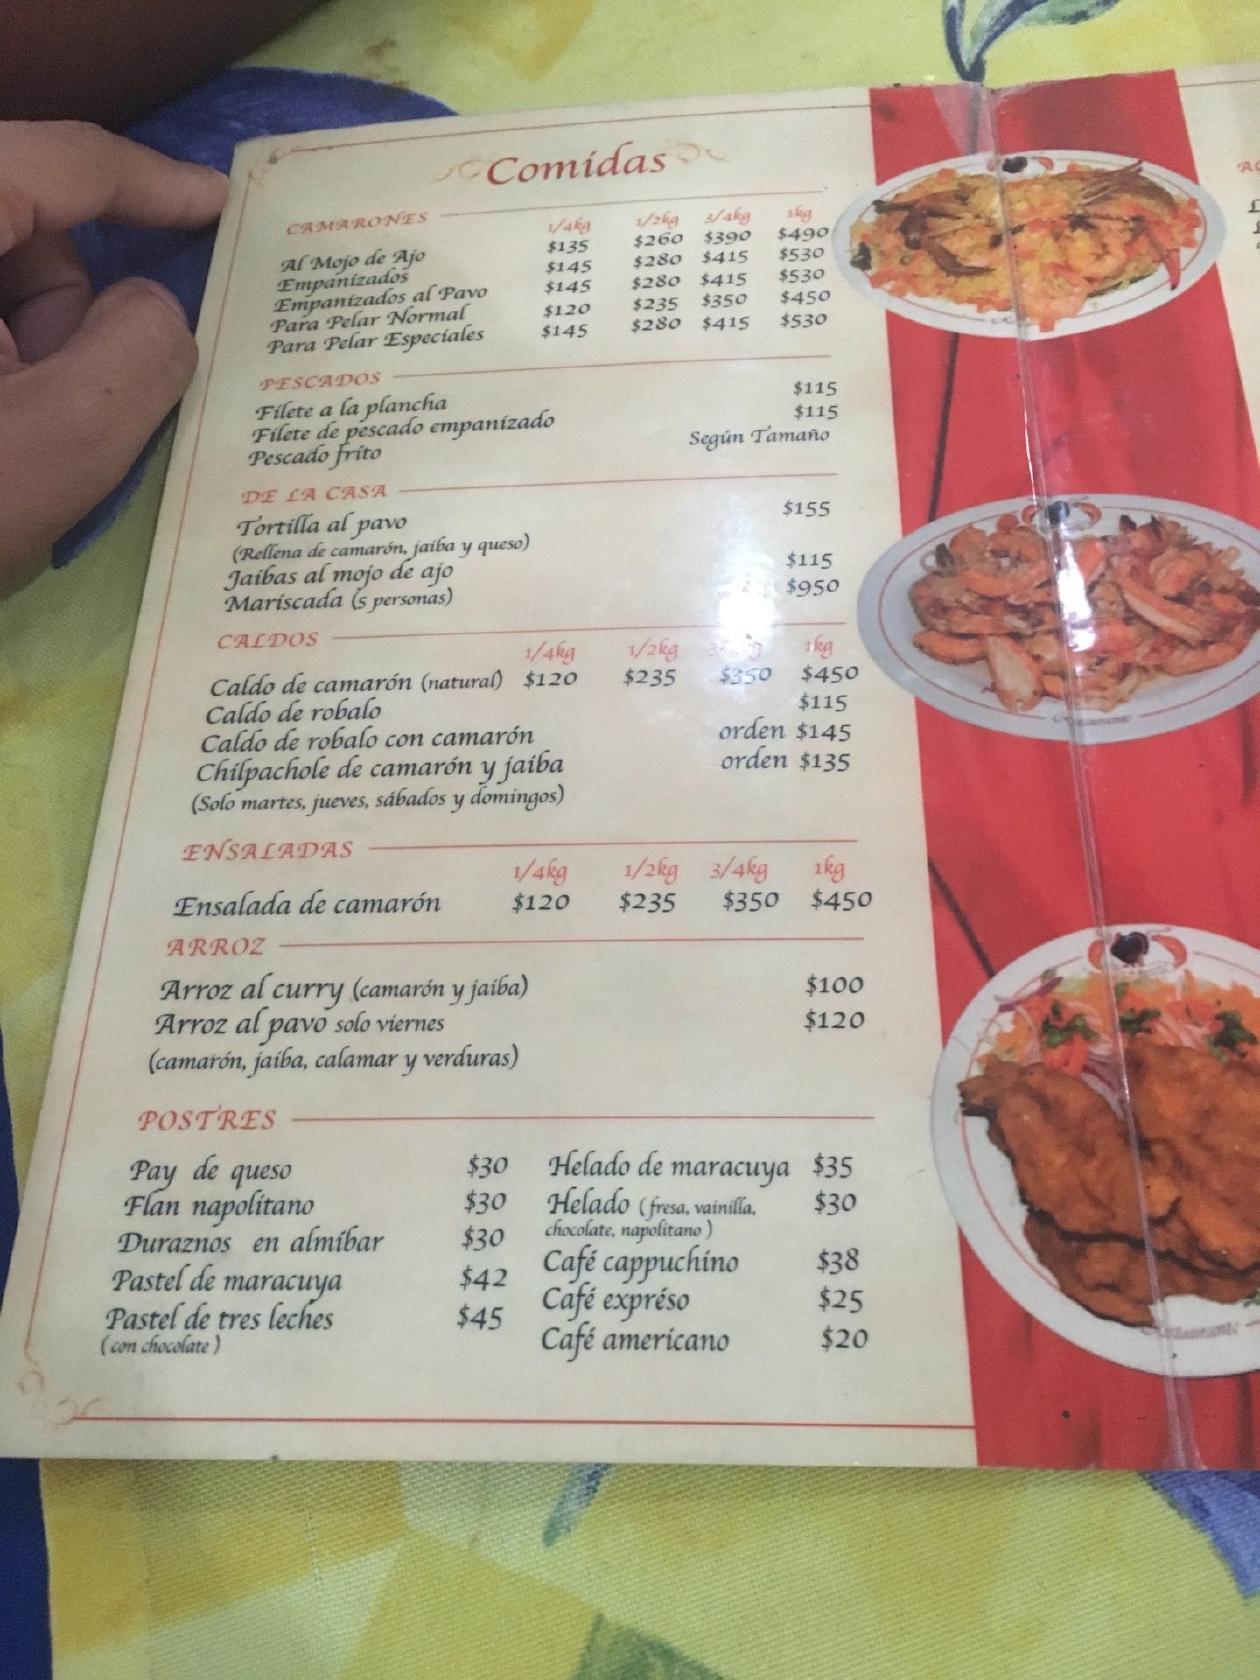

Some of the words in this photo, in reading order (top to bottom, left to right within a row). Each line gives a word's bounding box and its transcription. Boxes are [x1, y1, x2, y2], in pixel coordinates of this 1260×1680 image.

[486, 141, 668, 186] Comidas
[286, 212, 428, 235] CAMARONES
[548, 239, 589, 252] $135
[633, 233, 684, 248] $260
[703, 230, 751, 245] $390
[777, 226, 829, 241] $490
[280, 254, 304, 272] Al
[309, 254, 360, 272] Mojo
[392, 250, 426, 269] Ajo
[277, 267, 410, 296] Empanizados
[273, 288, 405, 316] Empanizados
[438, 286, 488, 301] Pavo
[543, 303, 590, 318] $120
[632, 297, 679, 312] $235
[702, 294, 747, 308] $350
[780, 289, 831, 304] $450
[270, 319, 319, 333] Para
[326, 311, 381, 330] Pelar
[386, 303, 472, 327] Normal
[541, 325, 589, 339] $145
[631, 318, 681, 333] $280
[702, 316, 749, 330] $415
[780, 313, 827, 329] $530
[267, 339, 316, 355] Para
[323, 332, 378, 351] Pelar
[383, 324, 484, 353] Especiales
[260, 372, 381, 392] PESCADOS
[793, 380, 838, 395] $115
[255, 402, 314, 421] Filete
[363, 392, 448, 422] plancha
[794, 403, 838, 420] $115
[344, 416, 423, 445] pescado
[430, 409, 555, 441] empanizado
[689, 429, 744, 451] Según
[751, 425, 830, 443] Tamaño
[248, 444, 329, 466] Pescado
[328, 443, 382, 471] frito
[241, 489, 276, 504] DE
[286, 487, 316, 502] LA
[326, 484, 387, 500] CASA
[782, 500, 831, 517] $155
[237, 514, 320, 537] Tortilla
[350, 515, 407, 540] pavo
[232, 544, 301, 564] (Rellena
[330, 540, 408, 559] camarón,
[411, 536, 455, 559] jaiba
[477, 533, 530, 552] queso)
[786, 552, 833, 569] $115
[224, 564, 297, 591] Jaibas
[333, 566, 383, 589] mojo
[421, 564, 454, 587] ajo
[786, 578, 840, 598] $950
[224, 587, 343, 613] Mariscada
[369, 586, 454, 614] personas)
[216, 631, 319, 650] CALDOS
[525, 640, 576, 665] 1/4kg
[629, 638, 678, 663] 1/2kg
[804, 634, 833, 660] 1kg
[210, 673, 276, 697] Caldo
[313, 673, 412, 694] camarón
[421, 669, 503, 694] (natural)
[523, 671, 578, 687] $120
[623, 667, 677, 687] $235
[719, 665, 773, 685] $350
[801, 663, 859, 682] $450
[205, 701, 271, 725] Caldo
[311, 696, 382, 722] robalo
[799, 693, 848, 712] $115
[201, 728, 268, 753] Caldo
[308, 725, 378, 751] robalo
[385, 731, 425, 747] con
[431, 725, 535, 747] camarón
[719, 716, 786, 741] orden
[796, 722, 852, 742] $145
[195, 754, 330, 790] Chilpachole
[369, 754, 472, 777] camarón
[496, 750, 564, 784] jaiba
[721, 745, 788, 770] orden
[800, 752, 851, 772] $135
[191, 787, 235, 813] (Solo
[241, 793, 305, 811] martes,
[305, 793, 369, 817] jueves,
[376, 786, 446, 807] sábados
[470, 784, 565, 811] domingos)
[182, 838, 354, 862] ENSALADAS
[513, 858, 568, 885] 1/4kg
[624, 857, 678, 885] 1/2kg
[710, 855, 768, 885] 3/4kg
[814, 853, 845, 883] 1kg
[173, 890, 291, 917] Ensalada
[334, 892, 441, 914] camarón
[512, 892, 570, 913] $120
[619, 890, 677, 914] $235
[723, 890, 780, 912] $350
[811, 889, 872, 911] $450
[165, 937, 266, 956] ARROZ
[160, 978, 233, 1001] Arroz
[272, 980, 345, 1009] curry
[353, 976, 445, 1001] (camarón
[468, 974, 529, 1006] jaiba)
[805, 974, 864, 996] $100
[155, 1012, 228, 1035] Arroz
[259, 1015, 328, 1046] pavo
[335, 1011, 371, 1033] solo
[377, 1015, 445, 1032] viernes
[804, 1009, 865, 1031] $120
[148, 1049, 247, 1074] (camarón,
[247, 1046, 308, 1078] jaiba,
[315, 1046, 398, 1068] calamar
[423, 1042, 519, 1071] verduras)
[137, 1105, 276, 1132] POSTRES
[130, 1159, 177, 1191] Pay
[231, 1163, 292, 1190] queso
[467, 1154, 509, 1179] $30
[549, 1150, 630, 1177] Helado
[672, 1158, 791, 1187] maracuya
[812, 1153, 854, 1179] $35
[124, 1190, 180, 1217] Flan
[192, 1188, 315, 1228] napolitano
[464, 1192, 507, 1214] $30
[547, 1187, 630, 1215] Helado
[695, 1197, 756, 1217] vainilla,
[814, 1190, 857, 1216] $30
[118, 1232, 232, 1254] Duraznos
[462, 1226, 505, 1251] $30
[545, 1219, 616, 1238] chocolate,
[621, 1219, 702, 1244] napolitano
[543, 1244, 598, 1284] Café
[603, 1244, 739, 1285] cappuchino
[817, 1248, 860, 1275] $38
[112, 1264, 191, 1292] Pastel
[223, 1272, 343, 1305] maracuya
[459, 1267, 507, 1291] $42
[543, 1282, 598, 1321] Café
[603, 1286, 690, 1322] expréso
[818, 1285, 864, 1314] $25
[106, 1302, 186, 1331] Pastel
[219, 1310, 261, 1330] tres
[268, 1301, 334, 1331] leches
[456, 1304, 503, 1330] $45
[141, 1335, 210, 1355] chocolate
[541, 1321, 597, 1362] Café
[603, 1327, 730, 1352] americano
[821, 1324, 869, 1352] $20
